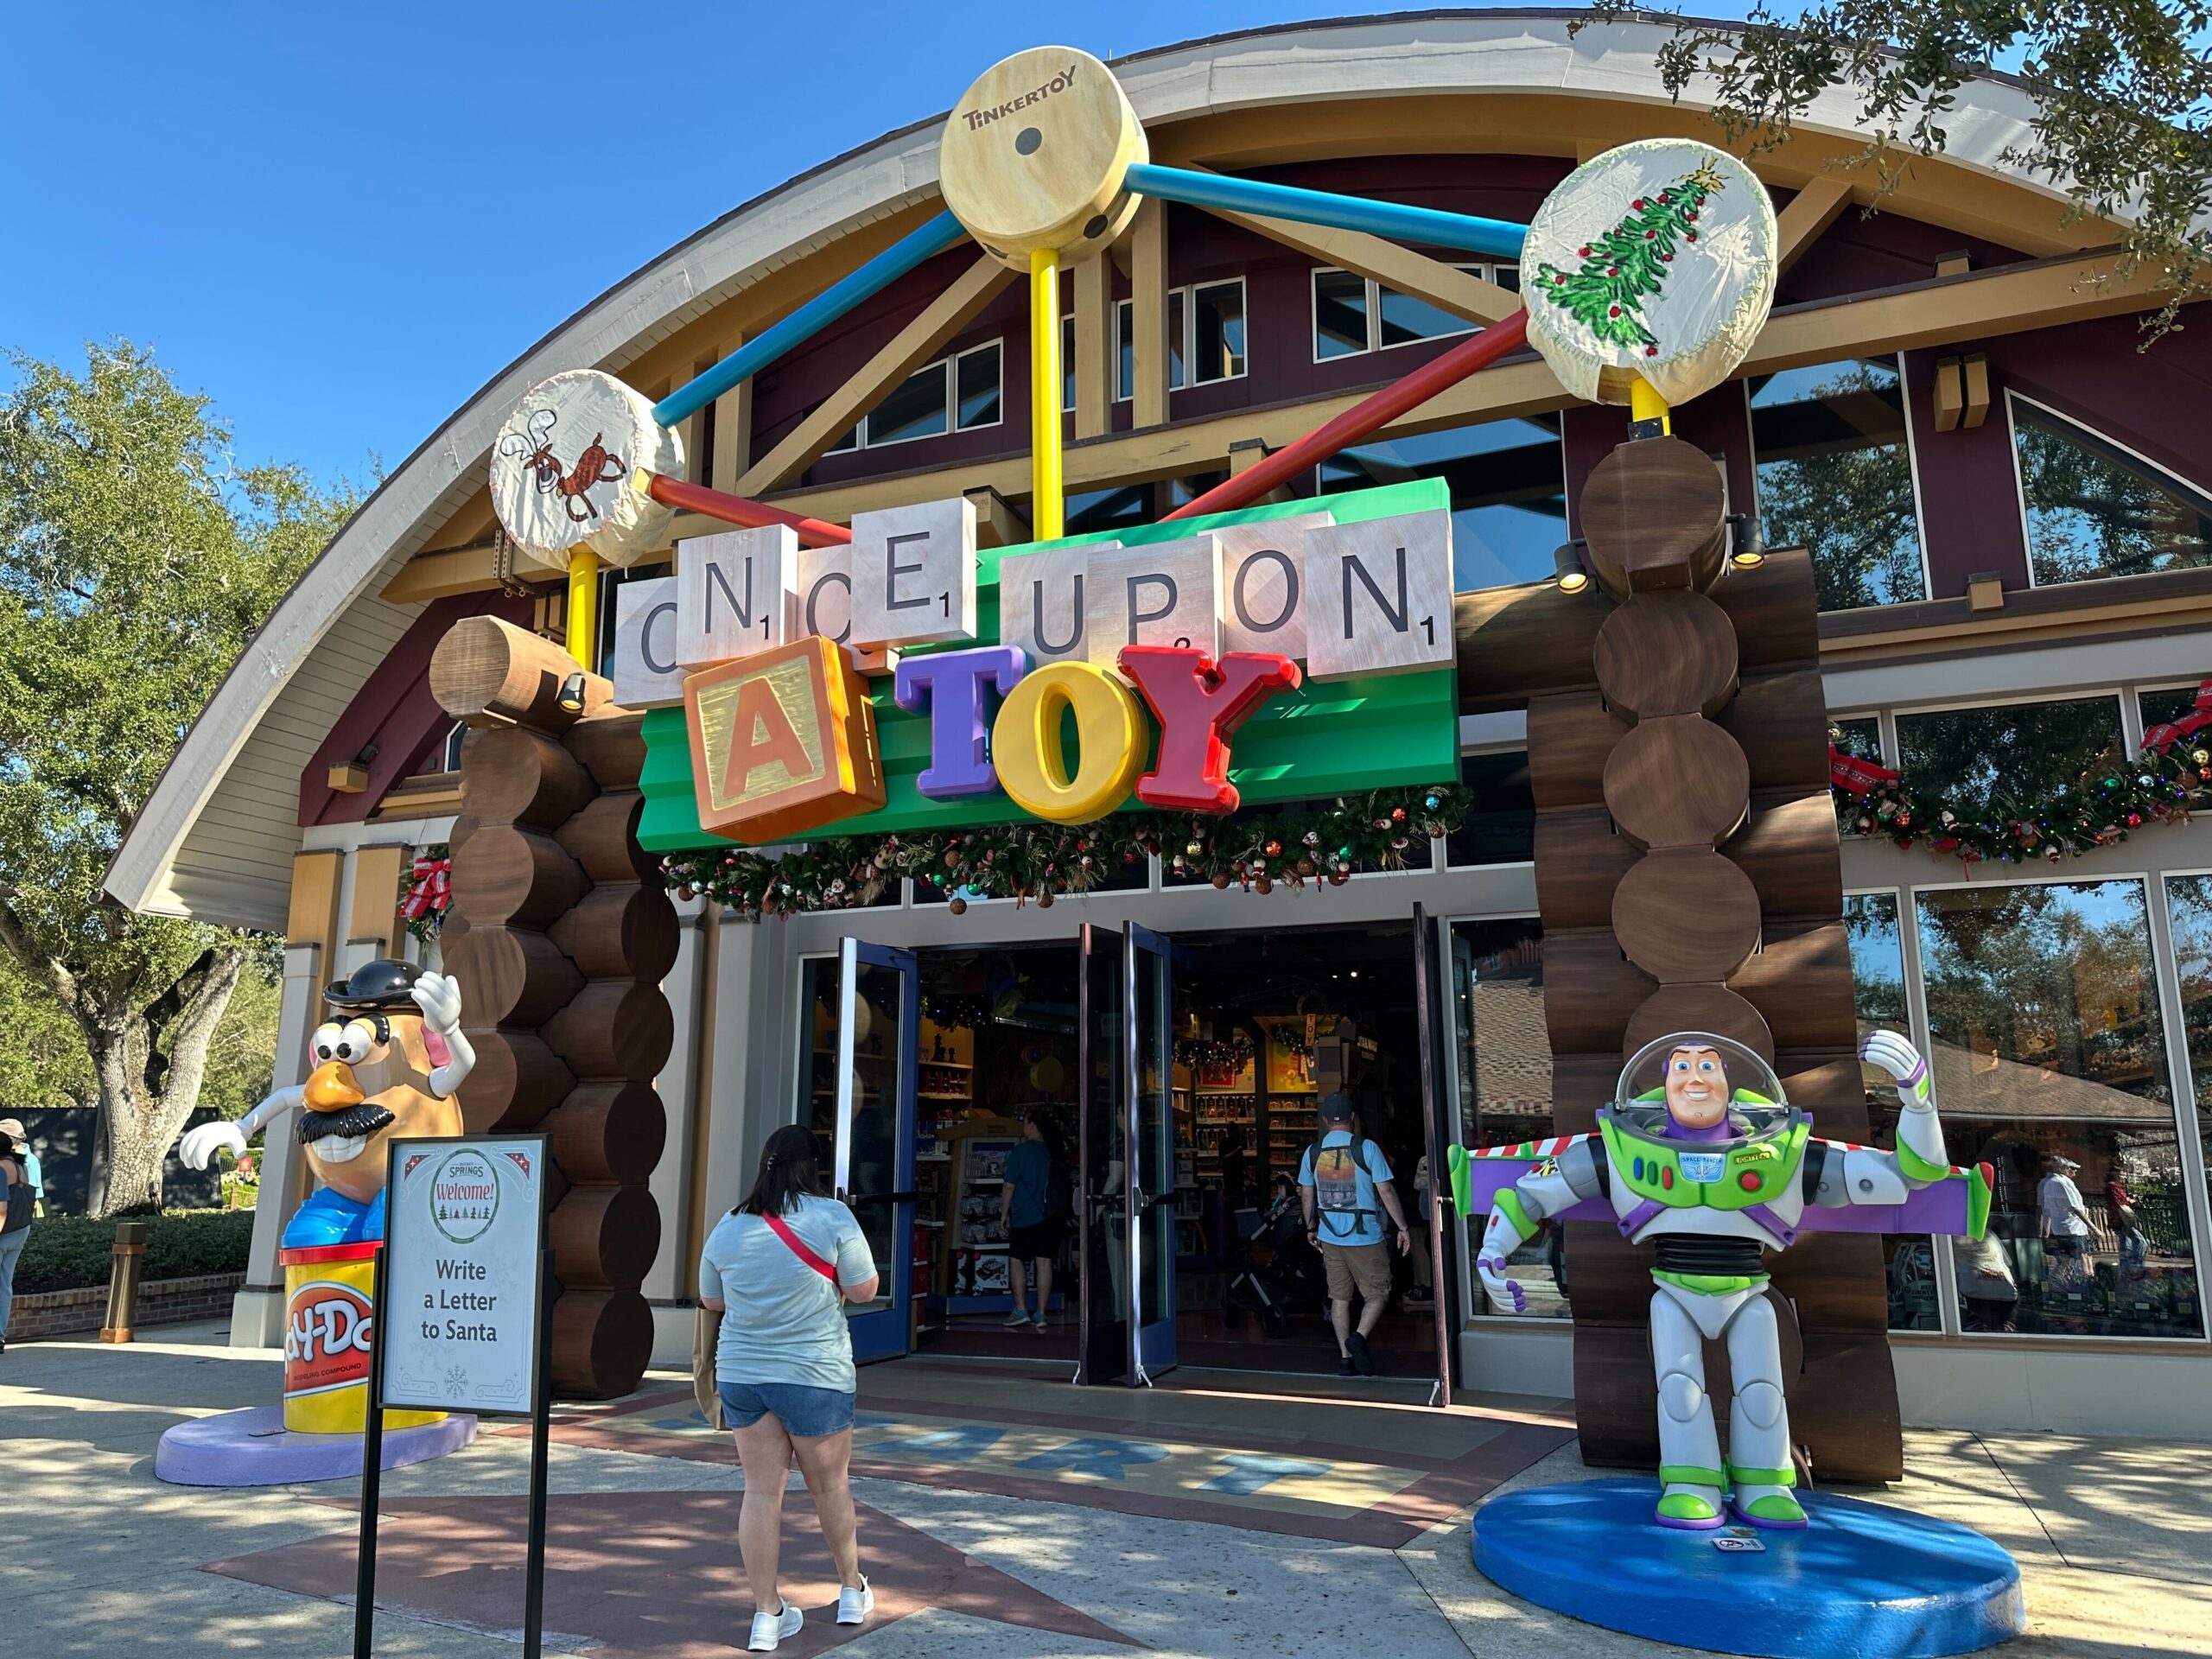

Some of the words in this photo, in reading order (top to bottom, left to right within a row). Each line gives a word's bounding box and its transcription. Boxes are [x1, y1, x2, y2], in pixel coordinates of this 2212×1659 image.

[1033, 547, 1408, 655] UPON
[722, 675, 815, 799] A
[894, 645, 1303, 825] TOY
[449, 1166, 484, 1178] SPRINGS
[436, 1182, 494, 1200] Welcome!
[435, 1259, 486, 1280] Write
[423, 1294, 434, 1309] a
[440, 1289, 497, 1311] Letter
[422, 1322, 440, 1339] to
[446, 1319, 498, 1342] Santa
[321, 1363, 361, 1376] COMPOUND
